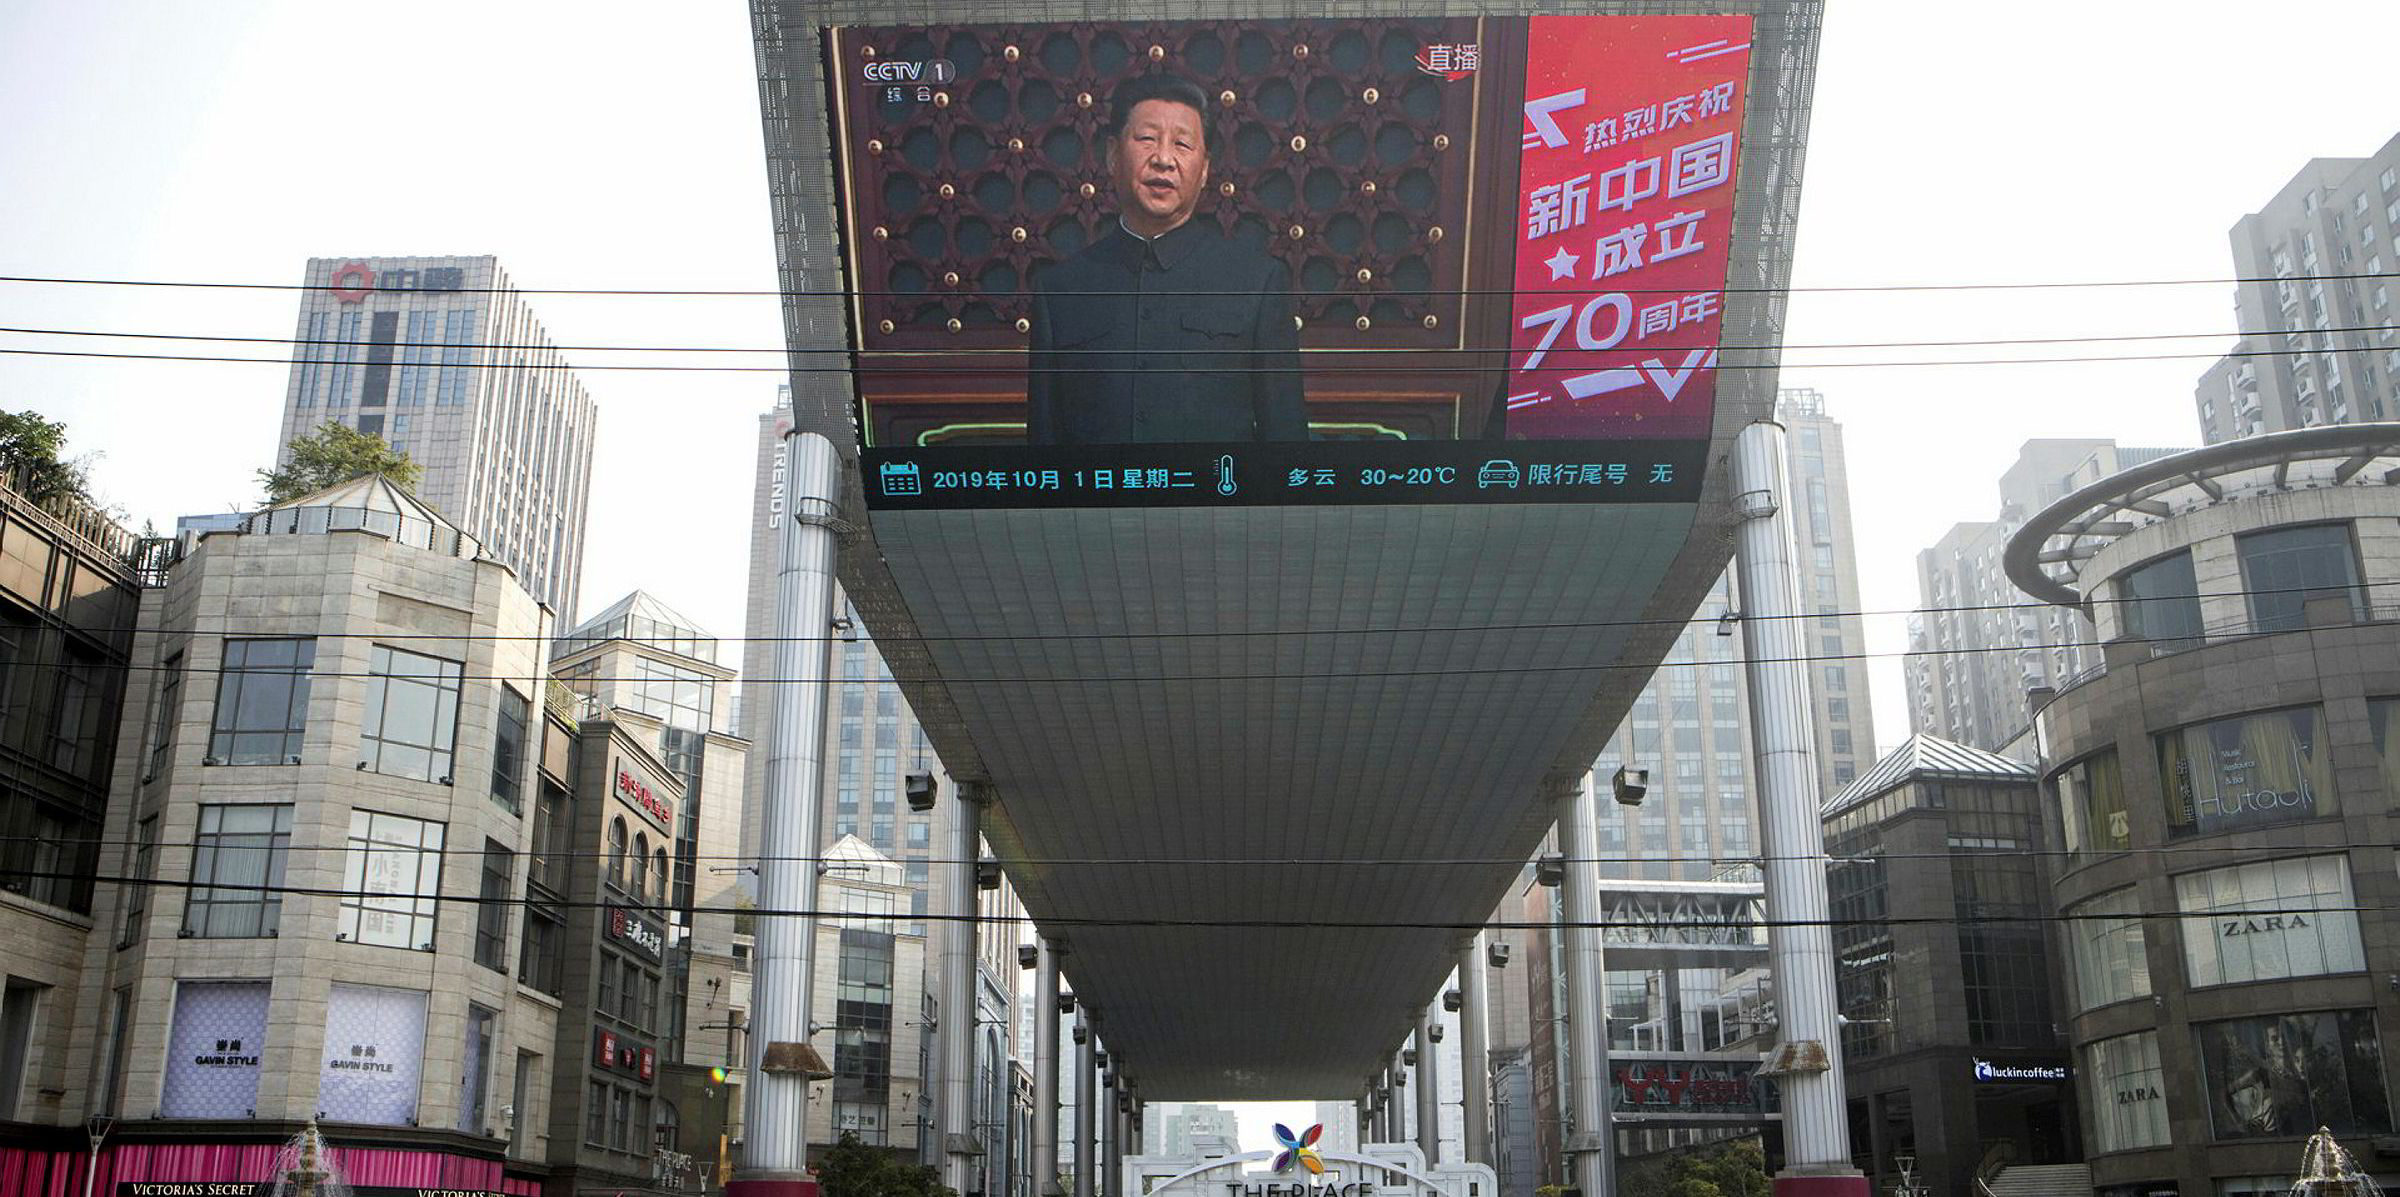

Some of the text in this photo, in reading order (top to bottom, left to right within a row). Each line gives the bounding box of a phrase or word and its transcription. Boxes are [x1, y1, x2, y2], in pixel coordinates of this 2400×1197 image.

[1427, 43, 1479, 73] 直播
[864, 61, 922, 81] CCTV
[1583, 80, 1736, 154] 热烈庆祝
[1528, 131, 1734, 241] 新中国
[1591, 210, 1706, 281] 成立
[1520, 291, 1720, 374] 70周年
[1287, 467, 1337, 487] 多云
[1528, 463, 1673, 485] 限行尾号 无
[2223, 913, 2310, 937] ZARA
[195, 1056, 259, 1066] GAVIN STYLE
[330, 1060, 394, 1073] GAVIN STYLE
[2118, 1086, 2160, 1104] ZARA
[132, 1183, 256, 1196] VICTORIA'S SECRET
